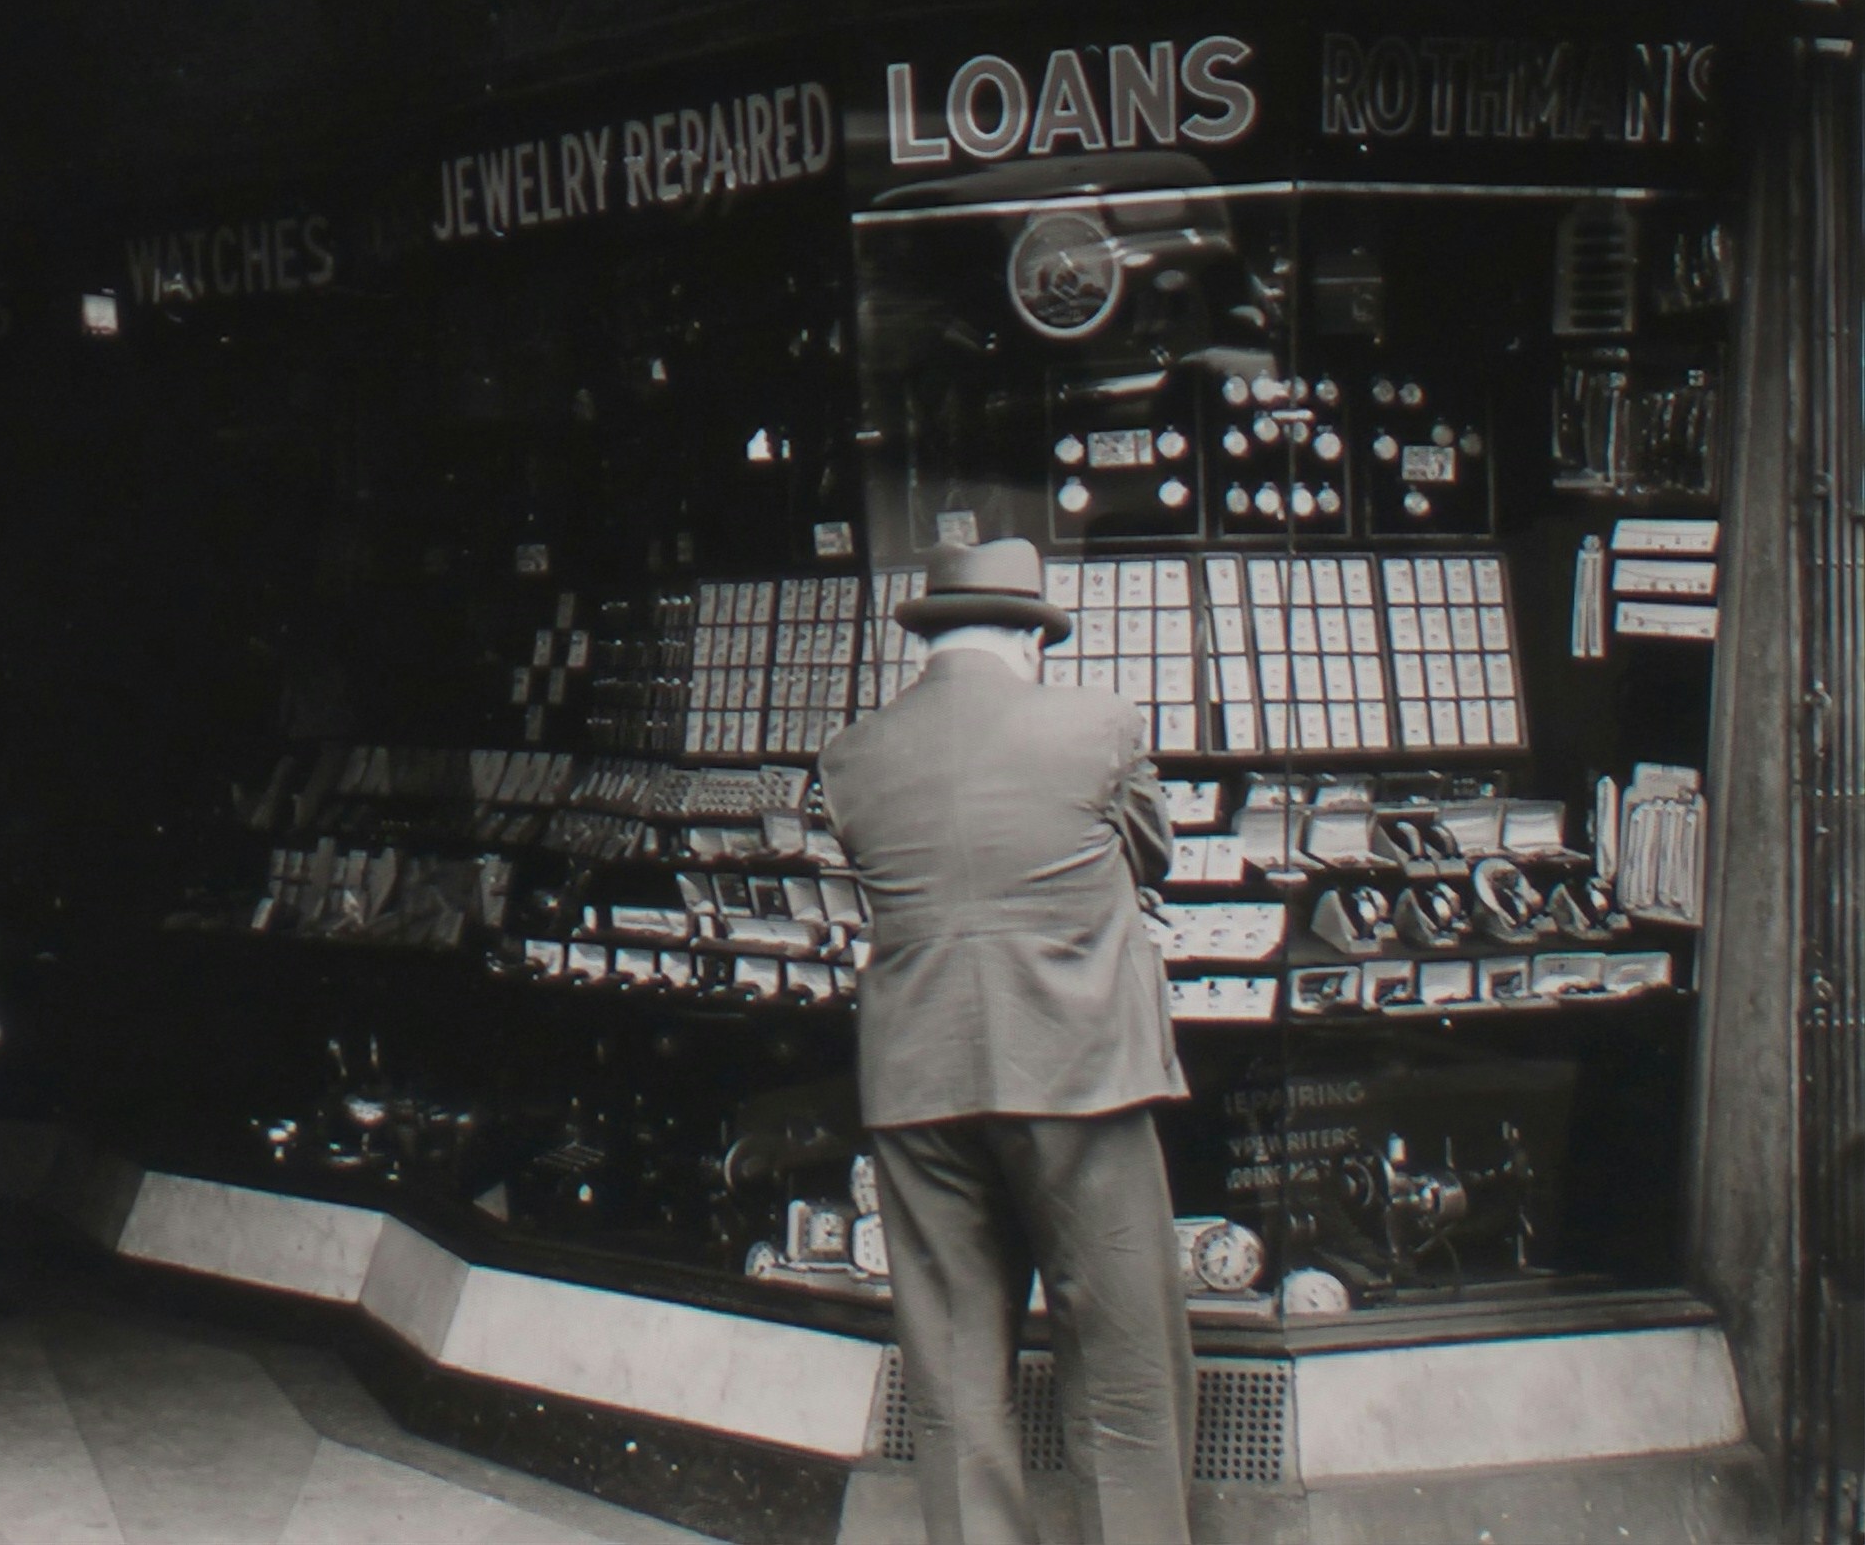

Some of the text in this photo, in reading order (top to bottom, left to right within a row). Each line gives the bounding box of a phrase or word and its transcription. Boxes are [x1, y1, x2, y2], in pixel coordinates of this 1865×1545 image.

[432, 82, 832, 241] JEWELRY REPAIRED
[887, 36, 1256, 166] LOANS
[128, 216, 334, 304] WATCHES
